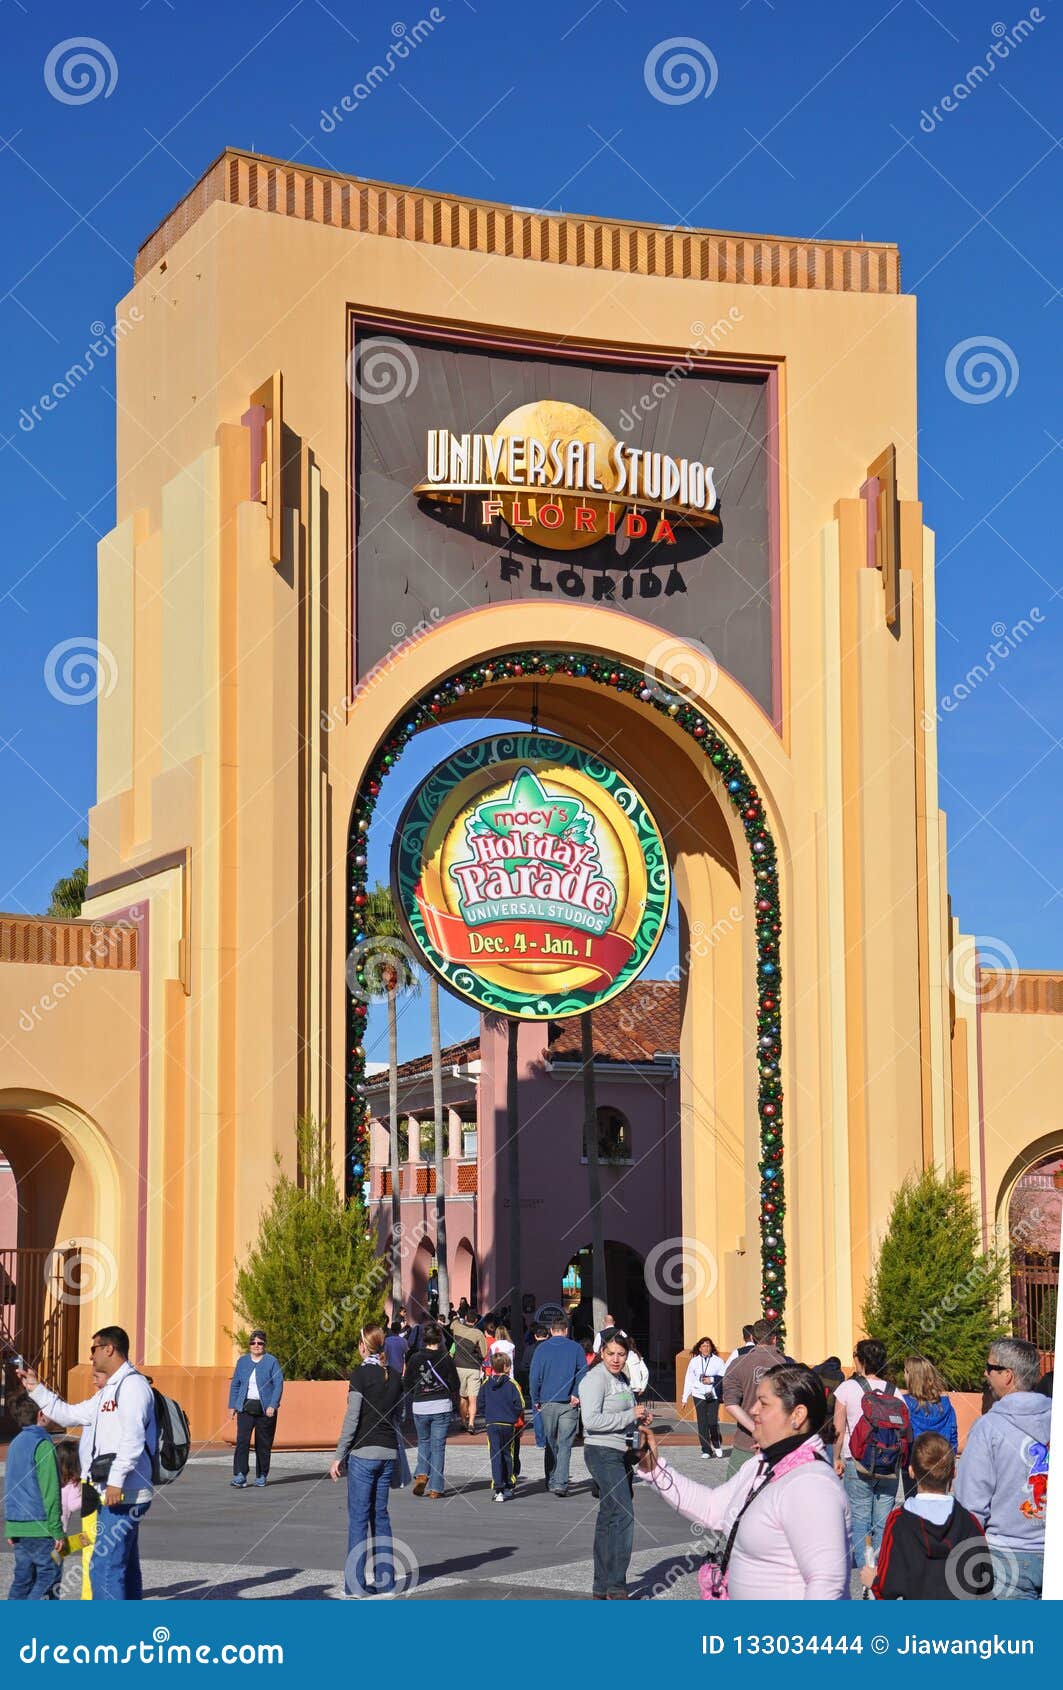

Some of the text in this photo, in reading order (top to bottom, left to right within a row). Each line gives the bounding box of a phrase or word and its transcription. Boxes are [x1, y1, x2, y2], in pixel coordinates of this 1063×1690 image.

[427, 429, 718, 511] UNIVERSAL STUDIOS
[482, 501, 677, 544] FLORIDA
[494, 806, 568, 828] macy's
[471, 830, 595, 872] Holiday
[454, 863, 613, 917] Parade
[466, 902, 604, 932] UNIVERSAL STUDIOS
[468, 932, 510, 953] Dec.
[541, 933, 579, 956] Jan.
[585, 938, 593, 957] 1
